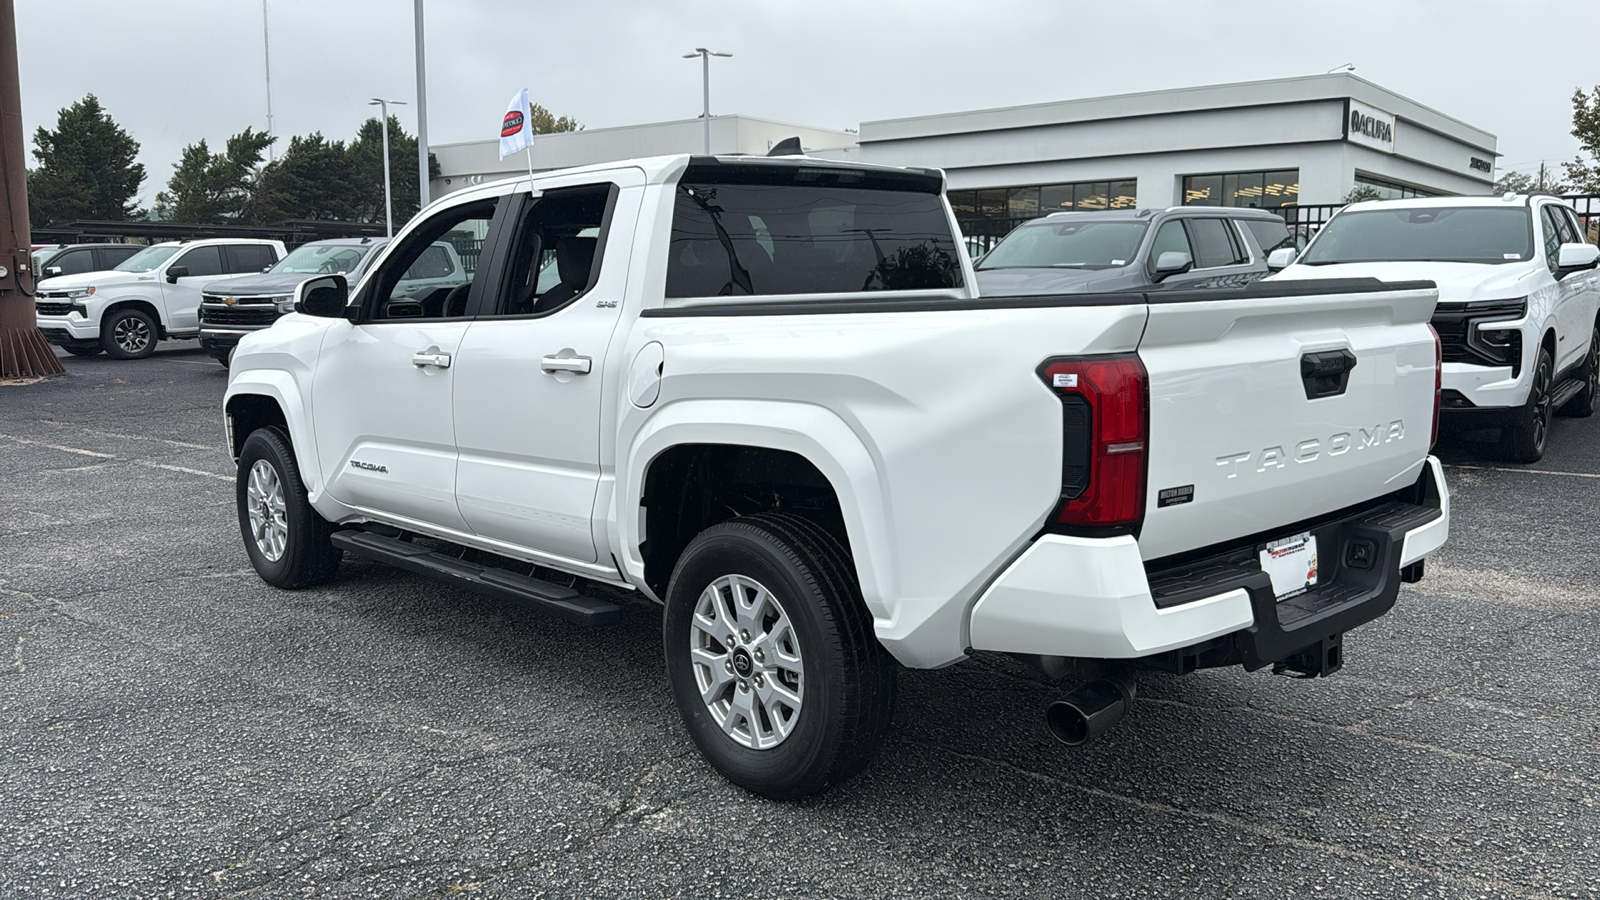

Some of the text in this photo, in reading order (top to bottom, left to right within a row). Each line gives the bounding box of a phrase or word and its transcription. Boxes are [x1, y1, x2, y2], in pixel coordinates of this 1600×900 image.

[1360, 113, 1392, 142] ACURA
[1215, 419, 1405, 478] TACOMA
[350, 460, 388, 474] TACOMA
